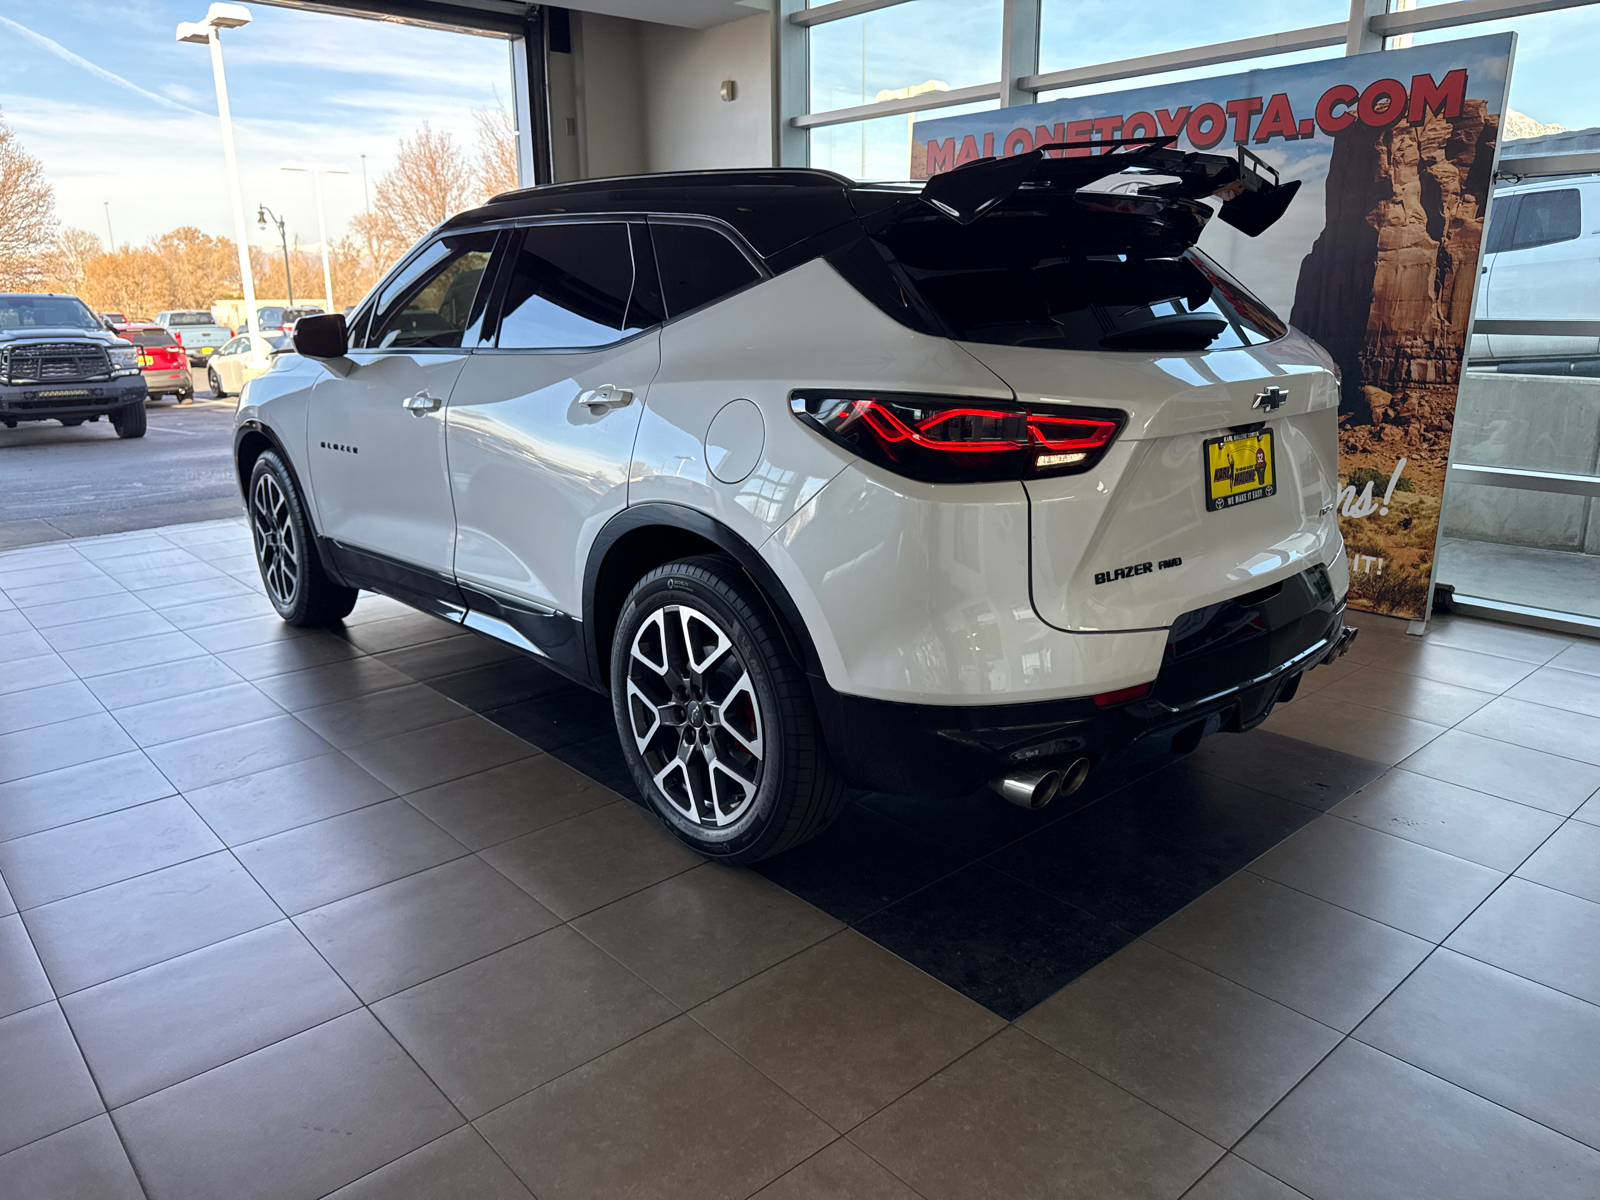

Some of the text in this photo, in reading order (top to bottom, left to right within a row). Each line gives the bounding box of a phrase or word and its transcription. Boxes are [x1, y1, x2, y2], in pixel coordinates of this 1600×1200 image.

[926, 68, 1468, 176] MALONETOYOTA.COM
[320, 441, 358, 454] BLAZER
[1257, 453, 1263, 463] 32
[1227, 496, 1235, 505] WE
[1235, 493, 1247, 504] MAKE
[1252, 489, 1263, 499] EASY
[1337, 457, 1407, 518] ns!
[1094, 557, 1183, 585] BLAZER AWD
[1353, 554, 1384, 576] IT!
